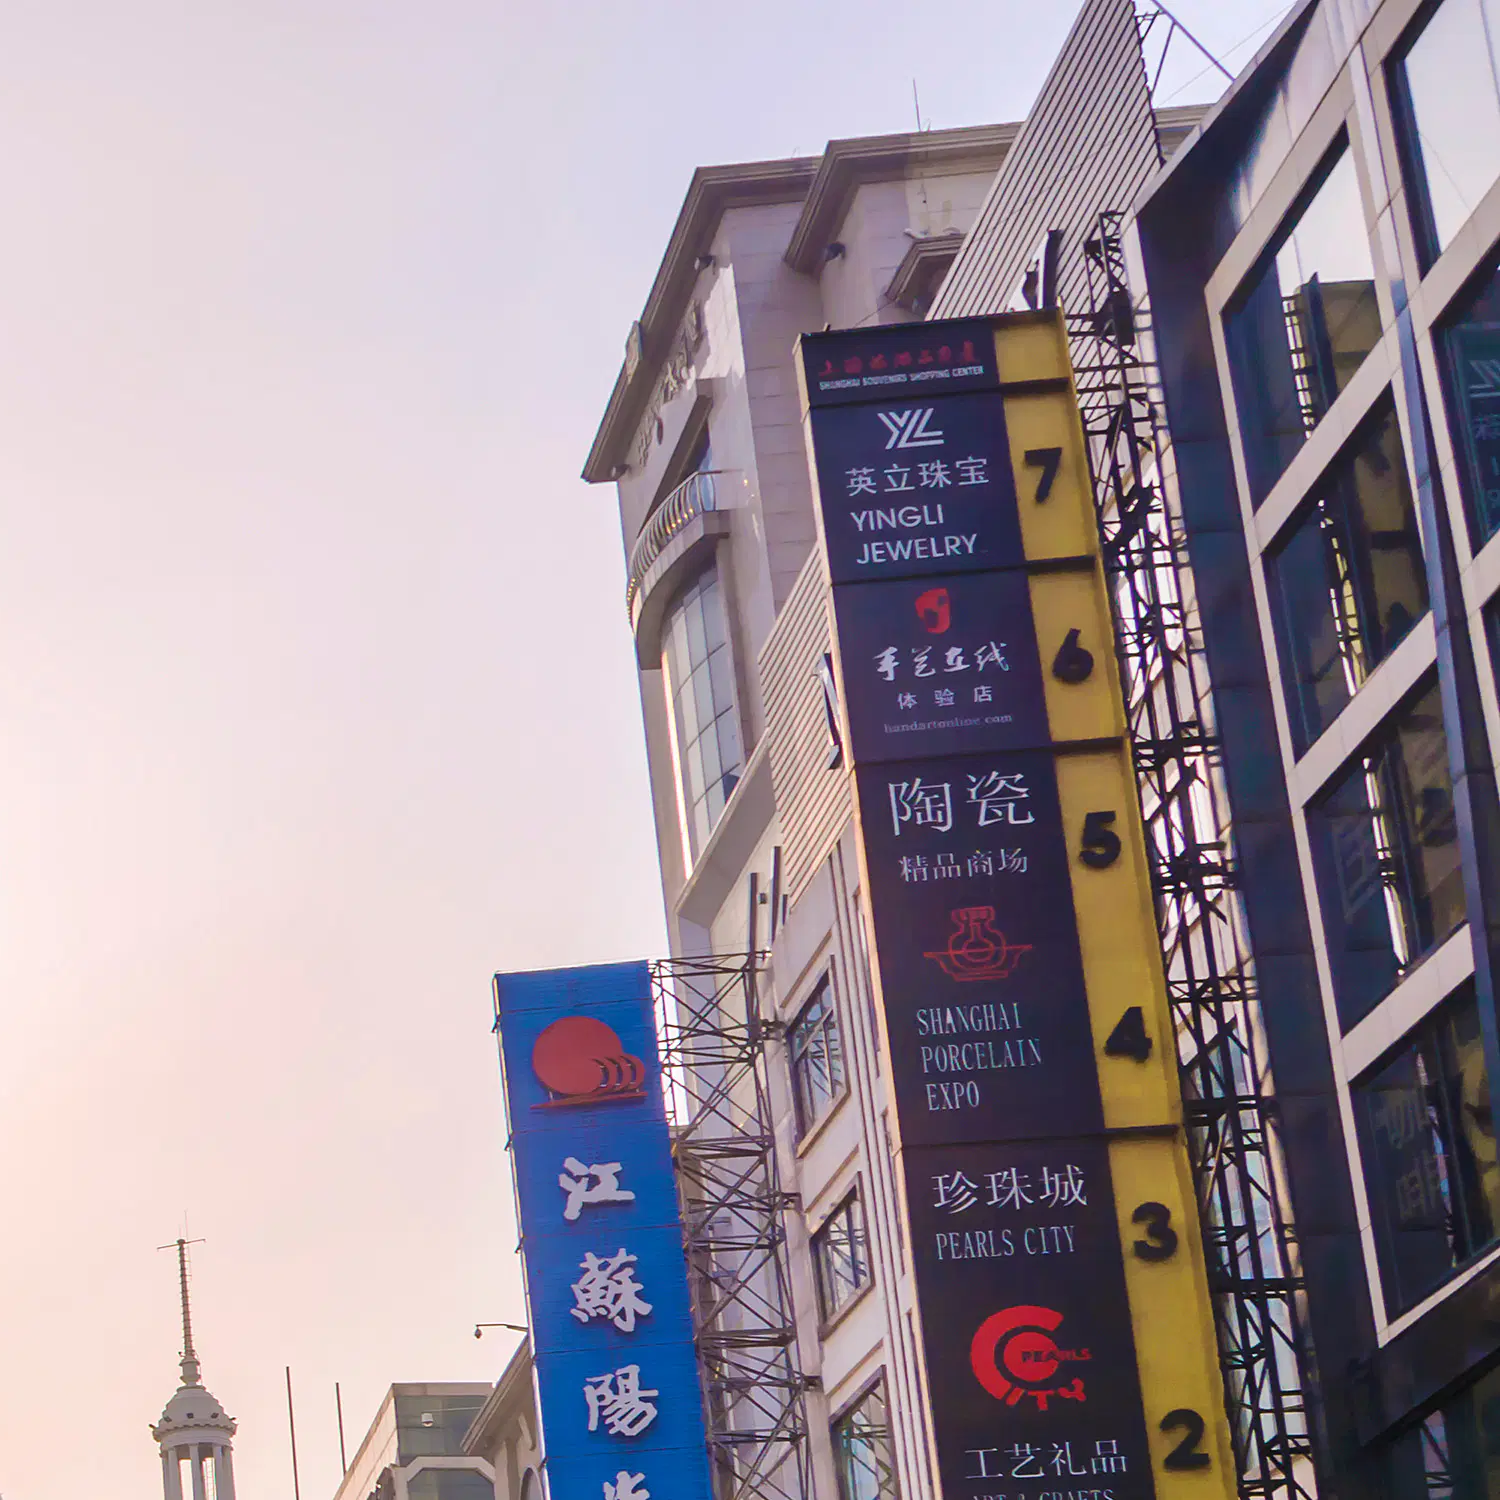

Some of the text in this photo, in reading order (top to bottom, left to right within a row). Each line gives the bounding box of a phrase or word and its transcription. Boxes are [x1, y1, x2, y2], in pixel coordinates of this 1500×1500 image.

[819, 378, 860, 391] SHANGHAI
[952, 365, 984, 377] CENTER
[846, 456, 989, 496] 英立珠宝
[1023, 447, 1063, 504] 7
[850, 504, 944, 532] YINGLI
[856, 534, 978, 564] JEWELRY
[1052, 628, 1095, 685] 6
[897, 685, 993, 710] 体验店
[888, 770, 1036, 836] 陶瓷
[1080, 811, 1122, 869] 5
[899, 848, 1029, 882] 精品商场
[917, 1003, 1022, 1036] SHANGHAI
[1103, 1006, 1153, 1064] 4
[921, 1038, 1043, 1073] PORCELAIN
[926, 1080, 980, 1111] EXPO
[931, 1164, 1088, 1215] 珍珠城
[935, 1225, 1076, 1260] PEARLS CITY
[1131, 1202, 1178, 1263] 3
[1159, 1409, 1212, 1470] 2
[964, 1440, 1127, 1479] 工艺礼品
